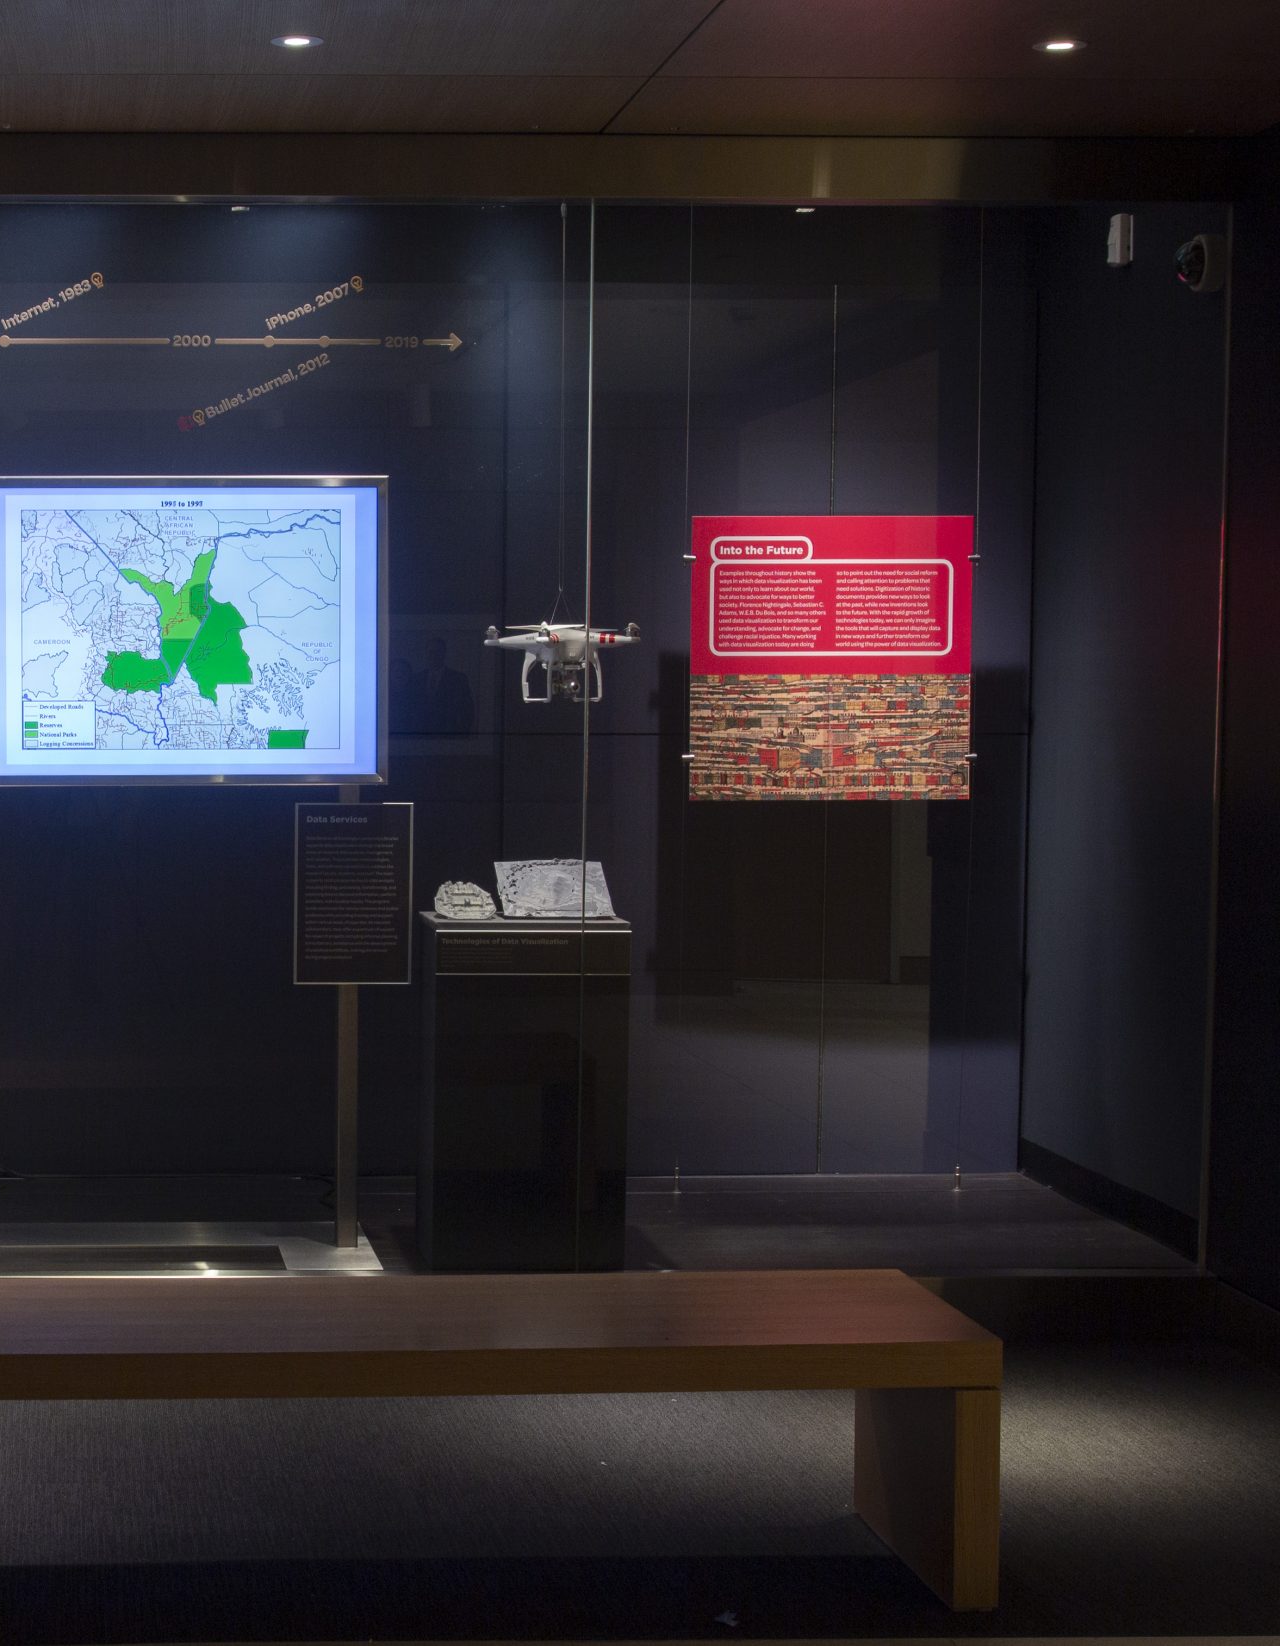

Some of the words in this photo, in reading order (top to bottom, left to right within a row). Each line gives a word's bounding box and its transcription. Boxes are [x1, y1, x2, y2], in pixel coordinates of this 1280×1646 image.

[0, 296, 60, 330] Internet,
[58, 279, 92, 303] 1983
[265, 302, 316, 330] iPhone,
[315, 282, 349, 308] 2007
[172, 335, 211, 347] 2000
[384, 335, 418, 348] 2019
[205, 393, 246, 420] Bullet
[245, 369, 299, 400] Journal,
[297, 352, 331, 377] 2012
[720, 546, 743, 555] Into
[746, 546, 763, 555] the
[766, 546, 803, 555] Future
